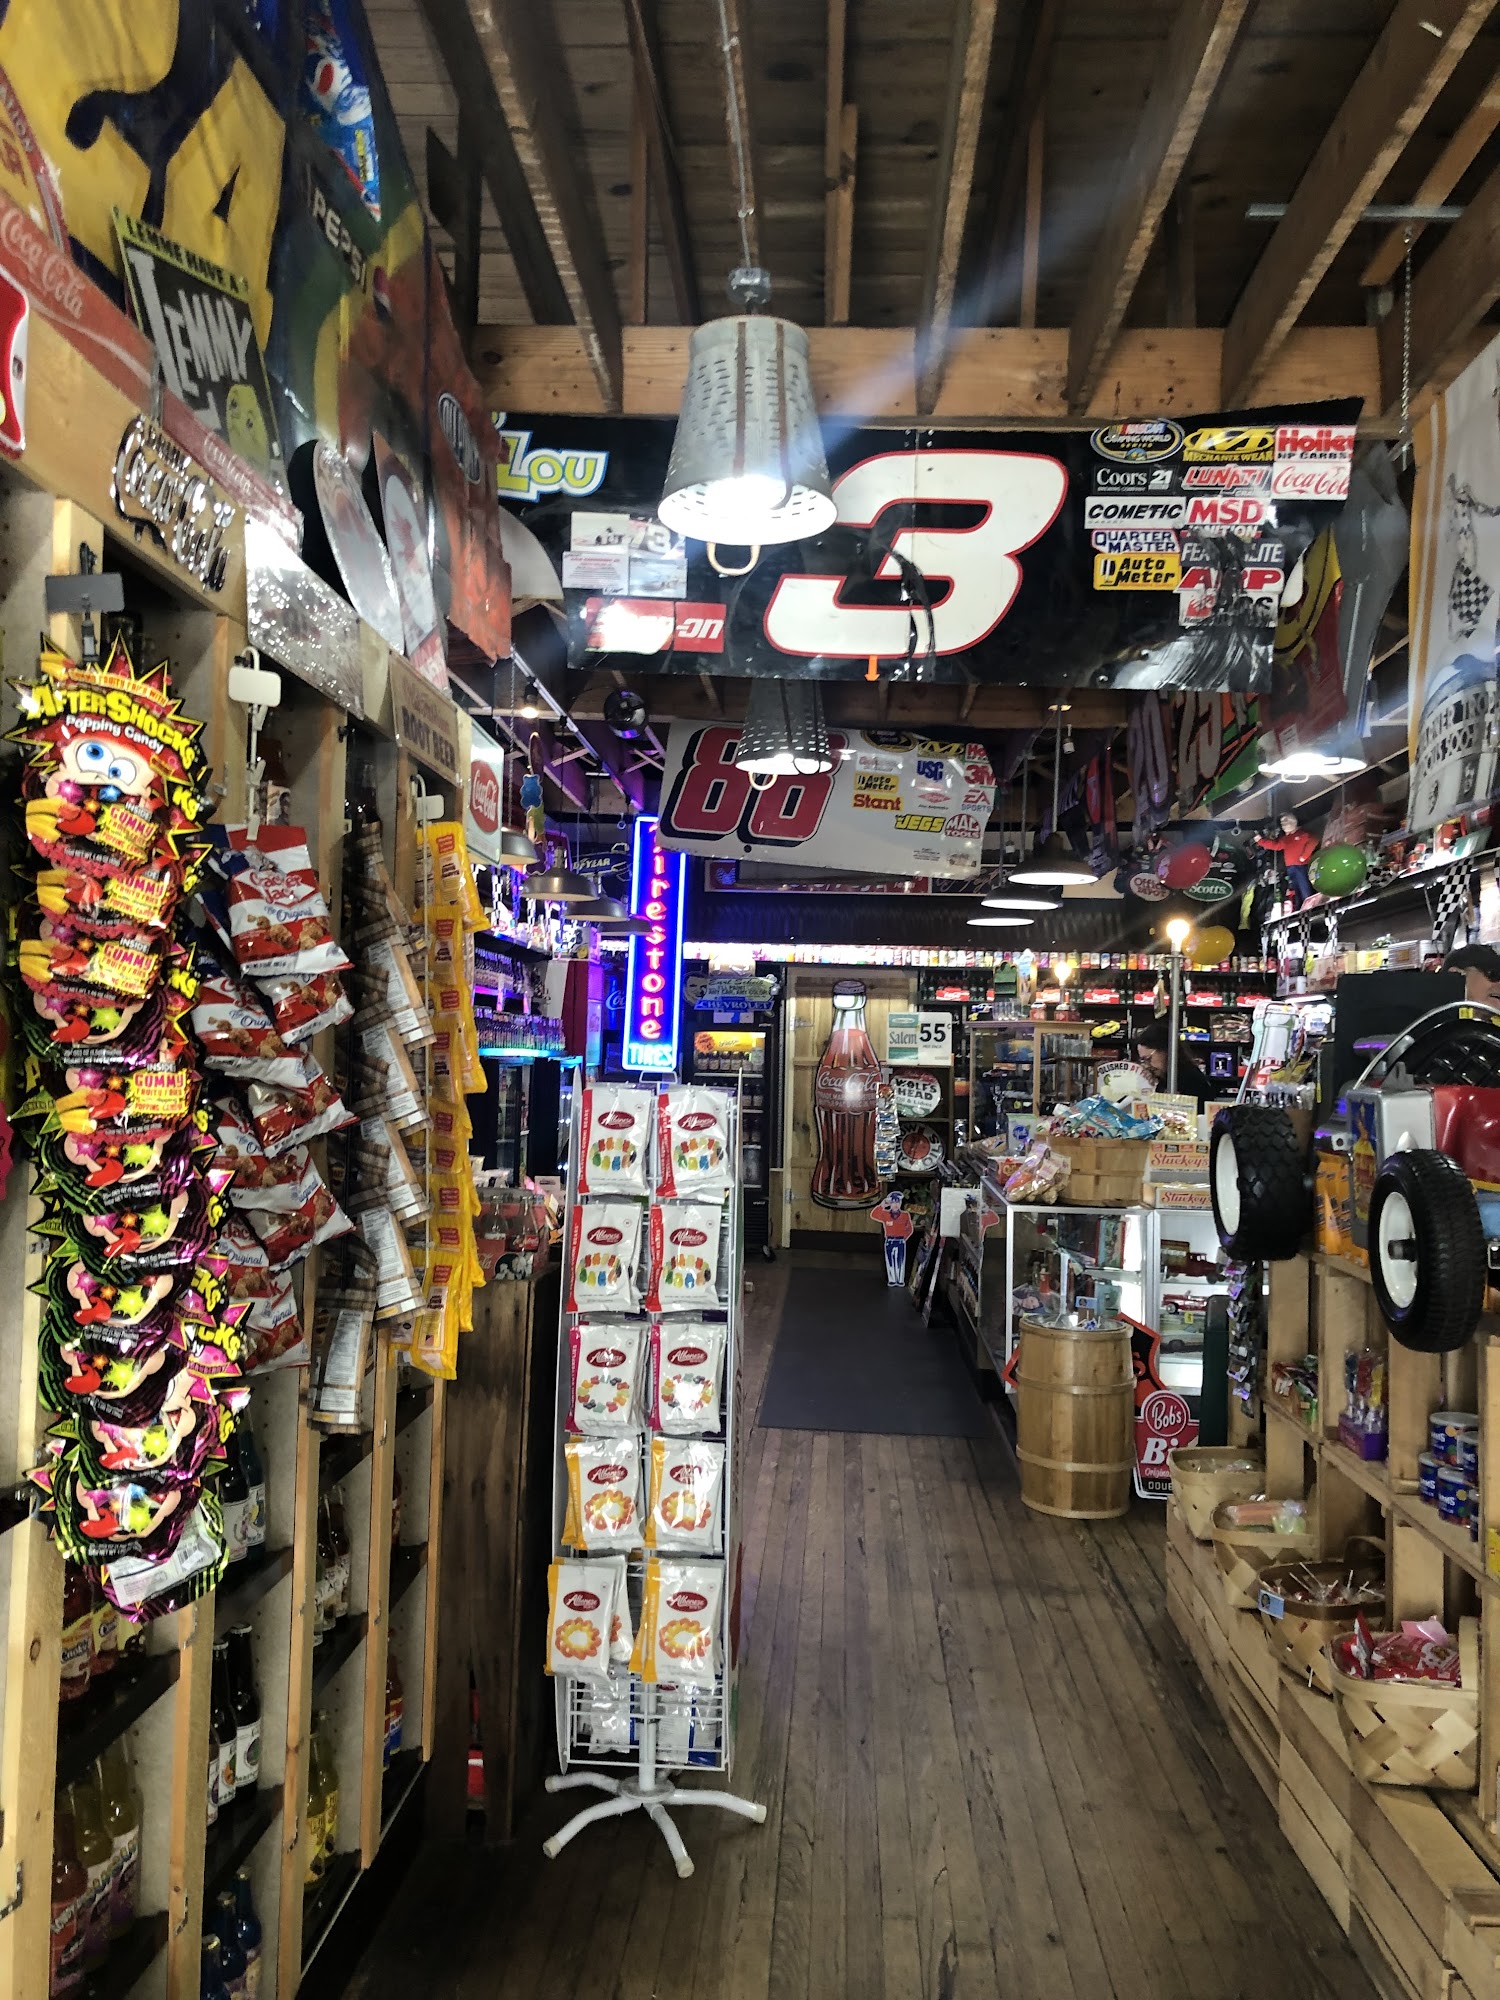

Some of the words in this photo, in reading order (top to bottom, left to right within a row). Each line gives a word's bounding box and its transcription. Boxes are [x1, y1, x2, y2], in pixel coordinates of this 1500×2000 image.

[312, 187, 367, 293] PEPSI
[1241, 452, 1274, 462] WEAR
[1096, 468, 1148, 486] Coors
[1088, 504, 1183, 520] COMETIC
[1188, 499, 1265, 524] MSD
[1094, 531, 1172, 546] QUARTER
[1188, 525, 1258, 538] NITON
[763, 448, 1069, 658] 3
[1108, 542, 1175, 553] MASTER
[1181, 542, 1284, 562] FEALITE
[1119, 557, 1166, 570] Auto
[1115, 570, 1175, 583] Meter
[124, 725, 164, 754] Candy
[668, 726, 849, 844] 88
[853, 793, 902, 811] Stant
[963, 789, 991, 805] EA
[961, 803, 992, 813] SPORTS
[895, 814, 946, 833] JEGS
[946, 814, 980, 830] MAC
[945, 829, 981, 838] TOOLS
[276, 907, 314, 922] Original
[103, 943, 153, 970] GUMMY
[700, 1001, 771, 1010] CHEVROLET
[240, 1015, 273, 1029] Origi
[889, 1031, 918, 1046] Salem
[1098, 1062, 1129, 1076] OLISHED
[134, 1073, 185, 1088] GUMMY
[897, 1087, 934, 1101] HEAD
[1150, 1153, 1209, 1168] Stuckey's
[221, 1222, 250, 1241] Jac
[227, 1250, 264, 1265] Original
[1151, 1400, 1182, 1430] Bob's
[1144, 1467, 1172, 1479] Origina
[1147, 1481, 1173, 1491] DOUB
